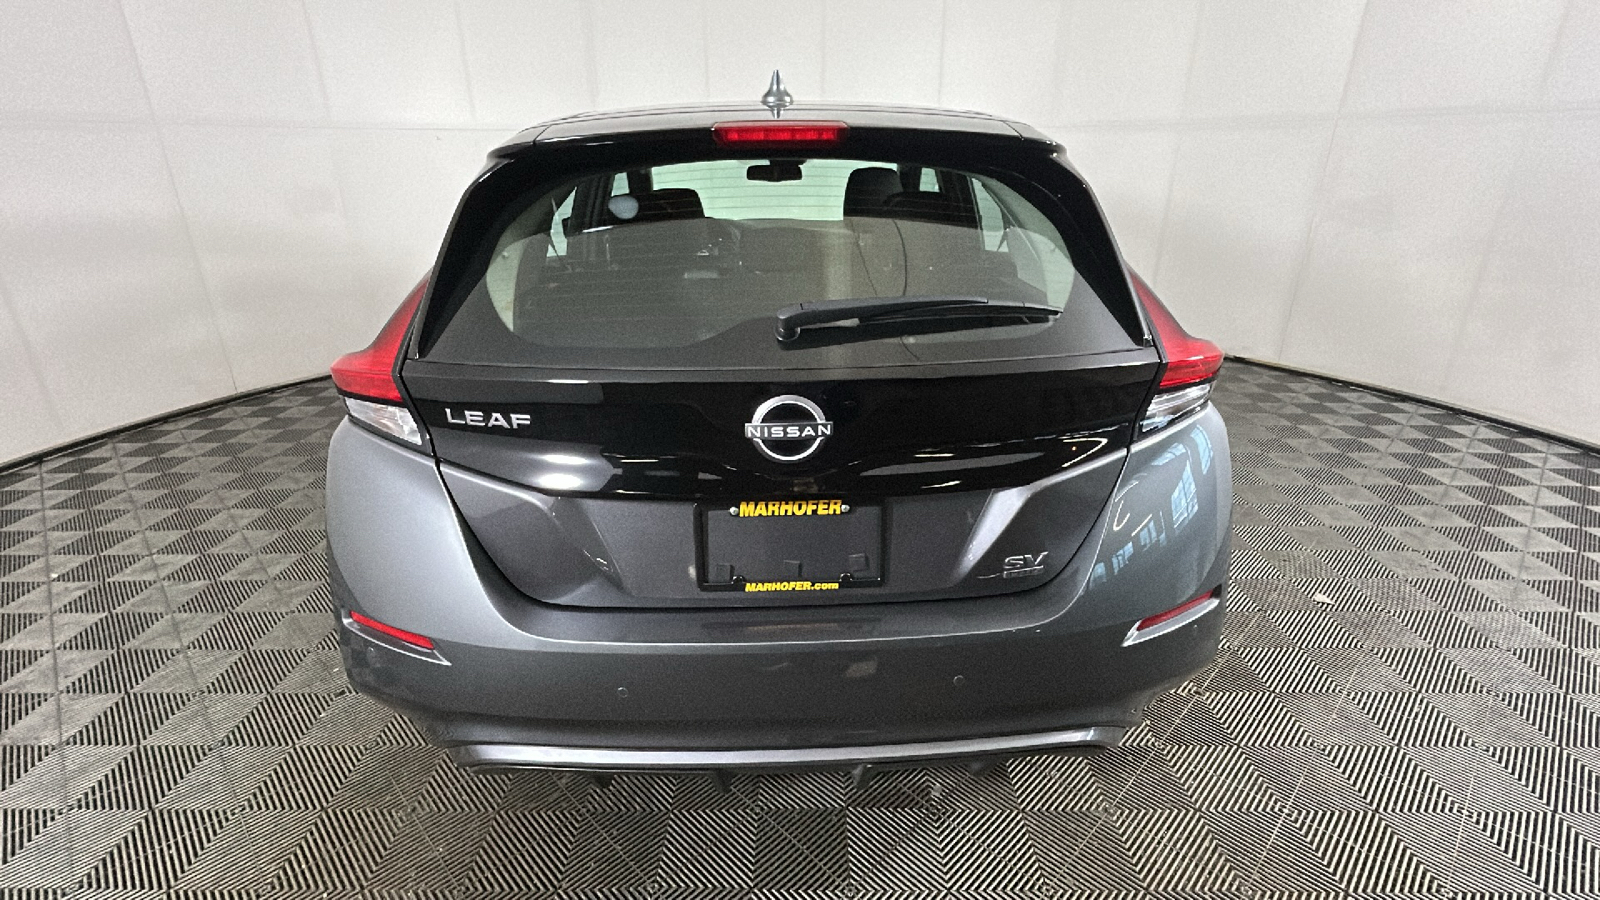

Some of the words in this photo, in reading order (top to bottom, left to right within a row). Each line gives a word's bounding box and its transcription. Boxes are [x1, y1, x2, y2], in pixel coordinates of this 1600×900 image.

[445, 408, 531, 429] LEAF
[747, 424, 831, 438] NISSAN
[739, 499, 842, 517] MARHOFER
[1003, 551, 1049, 569] SV
[745, 581, 839, 592] MARHOFER.com
